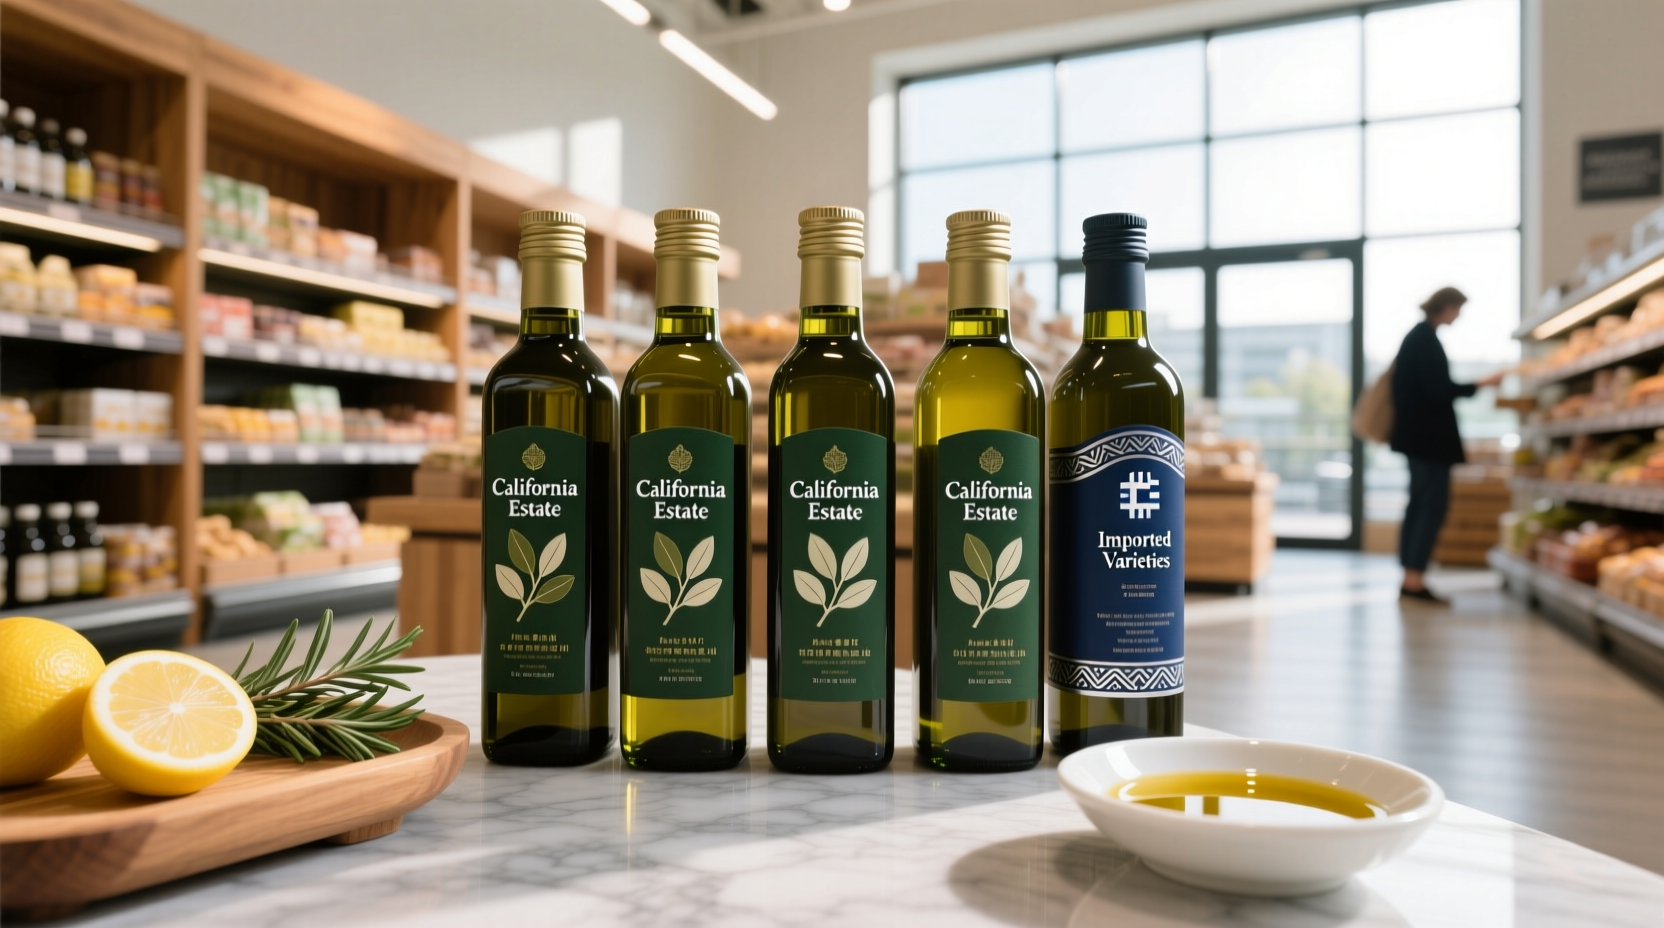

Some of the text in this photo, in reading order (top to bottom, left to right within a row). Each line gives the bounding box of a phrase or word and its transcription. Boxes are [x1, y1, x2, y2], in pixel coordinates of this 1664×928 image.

[492, 478, 578, 497] California
[637, 479, 726, 498] California
[790, 480, 880, 499] California
[945, 481, 1033, 500] California
[509, 500, 561, 517] Estate
[654, 502, 709, 520] Estate
[808, 503, 863, 521] Estate
[963, 503, 1018, 521] Estate
[1098, 531, 1172, 551] Imported
[1102, 551, 1171, 569] Varieties
